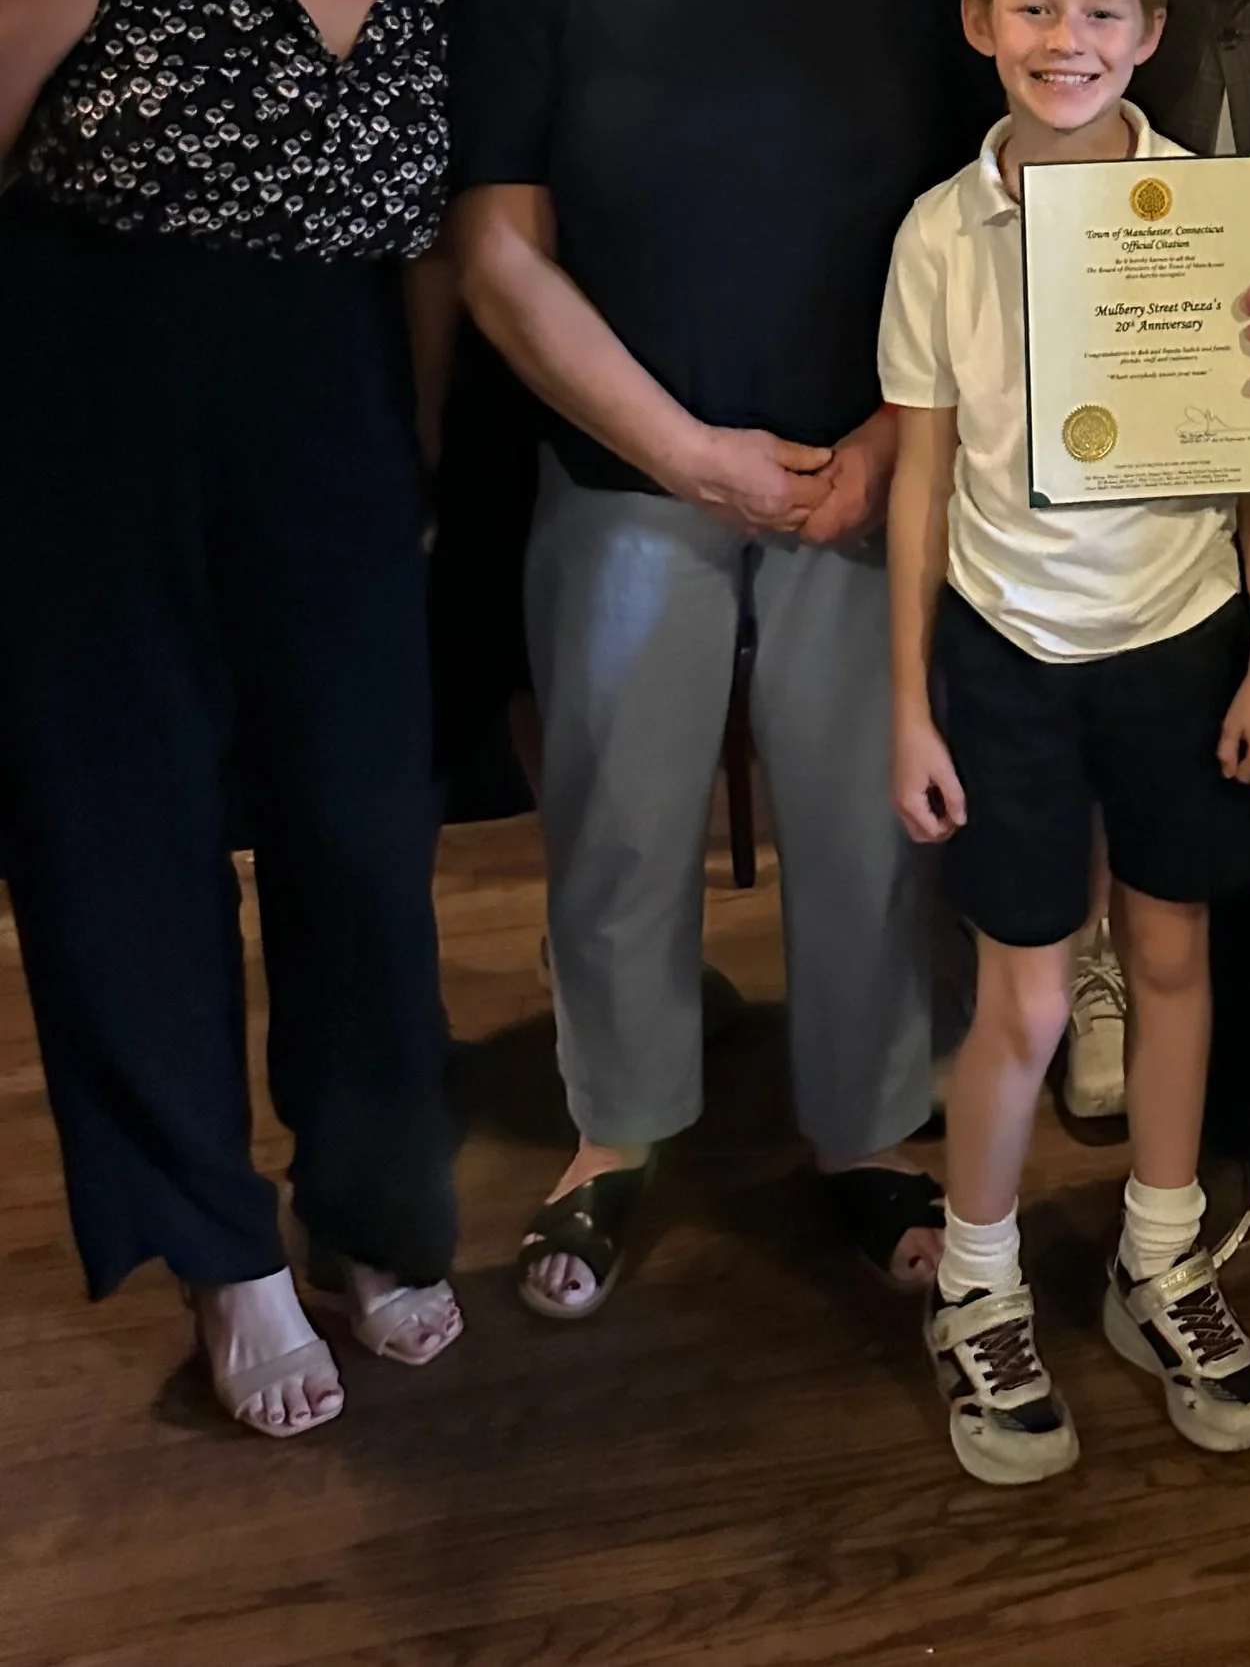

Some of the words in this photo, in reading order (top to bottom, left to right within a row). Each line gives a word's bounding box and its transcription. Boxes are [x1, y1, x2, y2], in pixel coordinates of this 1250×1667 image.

[1085, 230, 1110, 239] Town
[1112, 227, 1123, 241] of
[1175, 226, 1224, 236] Connecticut
[1121, 239, 1155, 253] Official
[1155, 239, 1190, 250] Citation
[1094, 302, 1146, 318] Mulberry
[1146, 302, 1179, 315] Street
[1181, 297, 1222, 312] Pizza's
[1136, 319, 1204, 333] Anniversary
